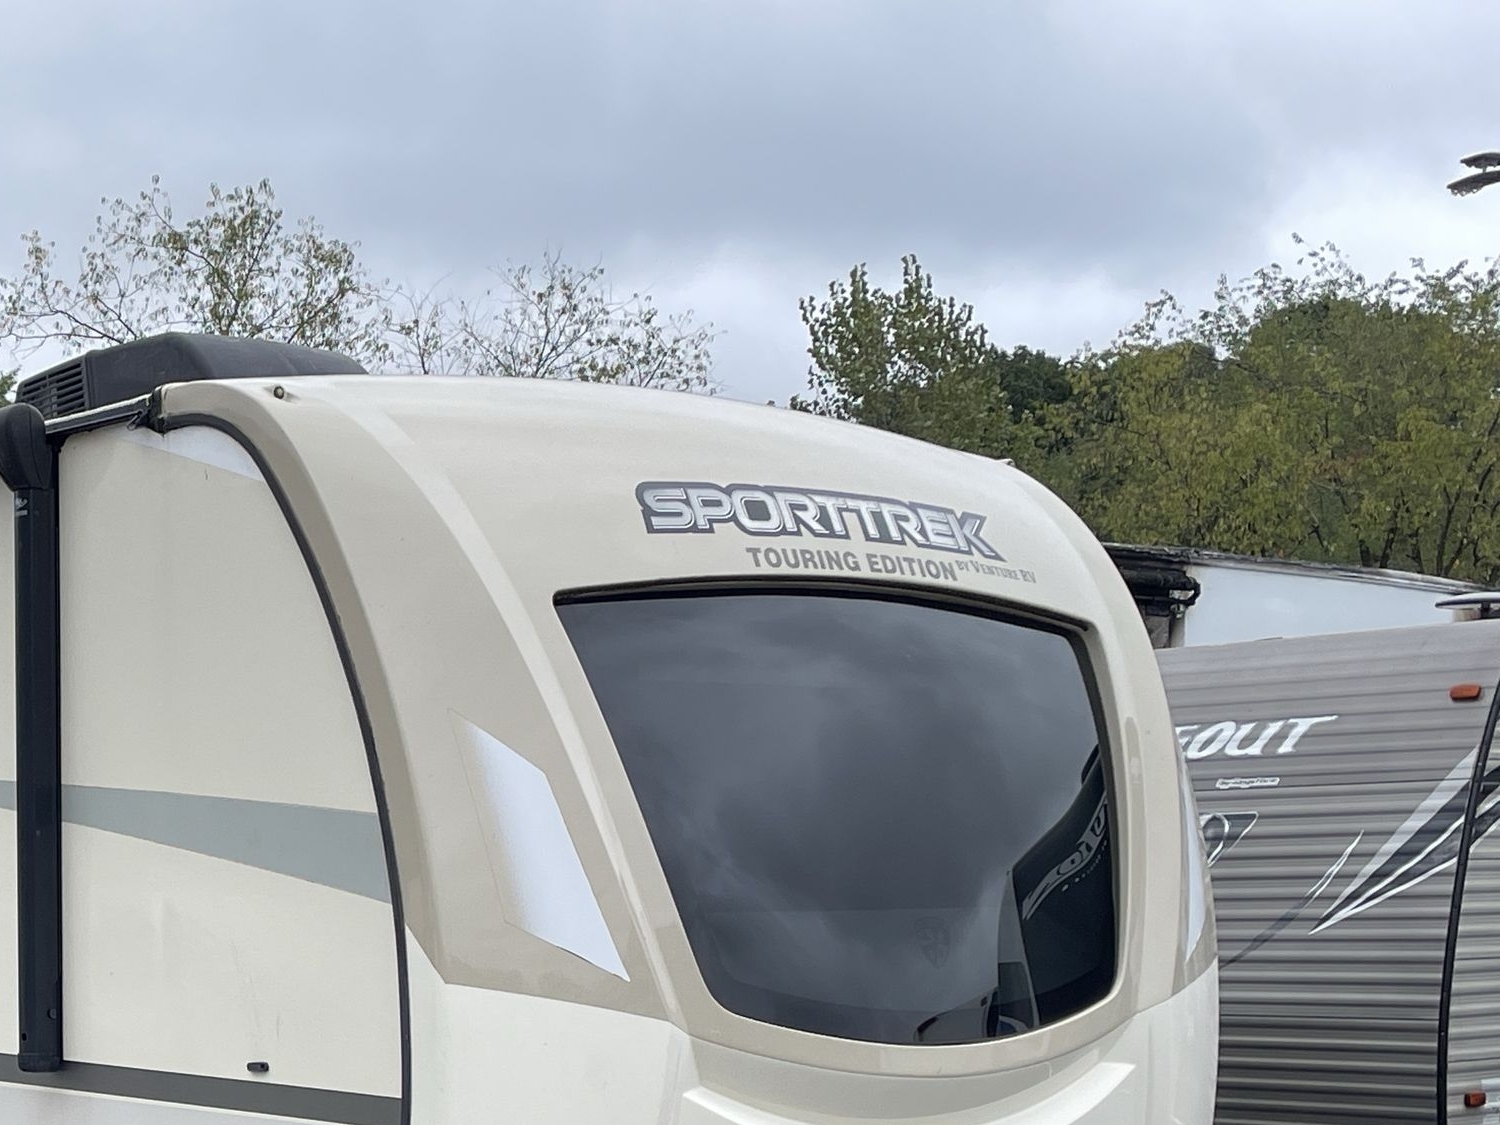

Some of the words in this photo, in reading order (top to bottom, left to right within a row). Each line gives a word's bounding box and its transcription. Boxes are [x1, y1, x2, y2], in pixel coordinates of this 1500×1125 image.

[636, 481, 1008, 563] SPORTTREK
[745, 546, 862, 573] TOURING
[865, 552, 959, 582] EDITION
[1018, 568, 1037, 584] RV
